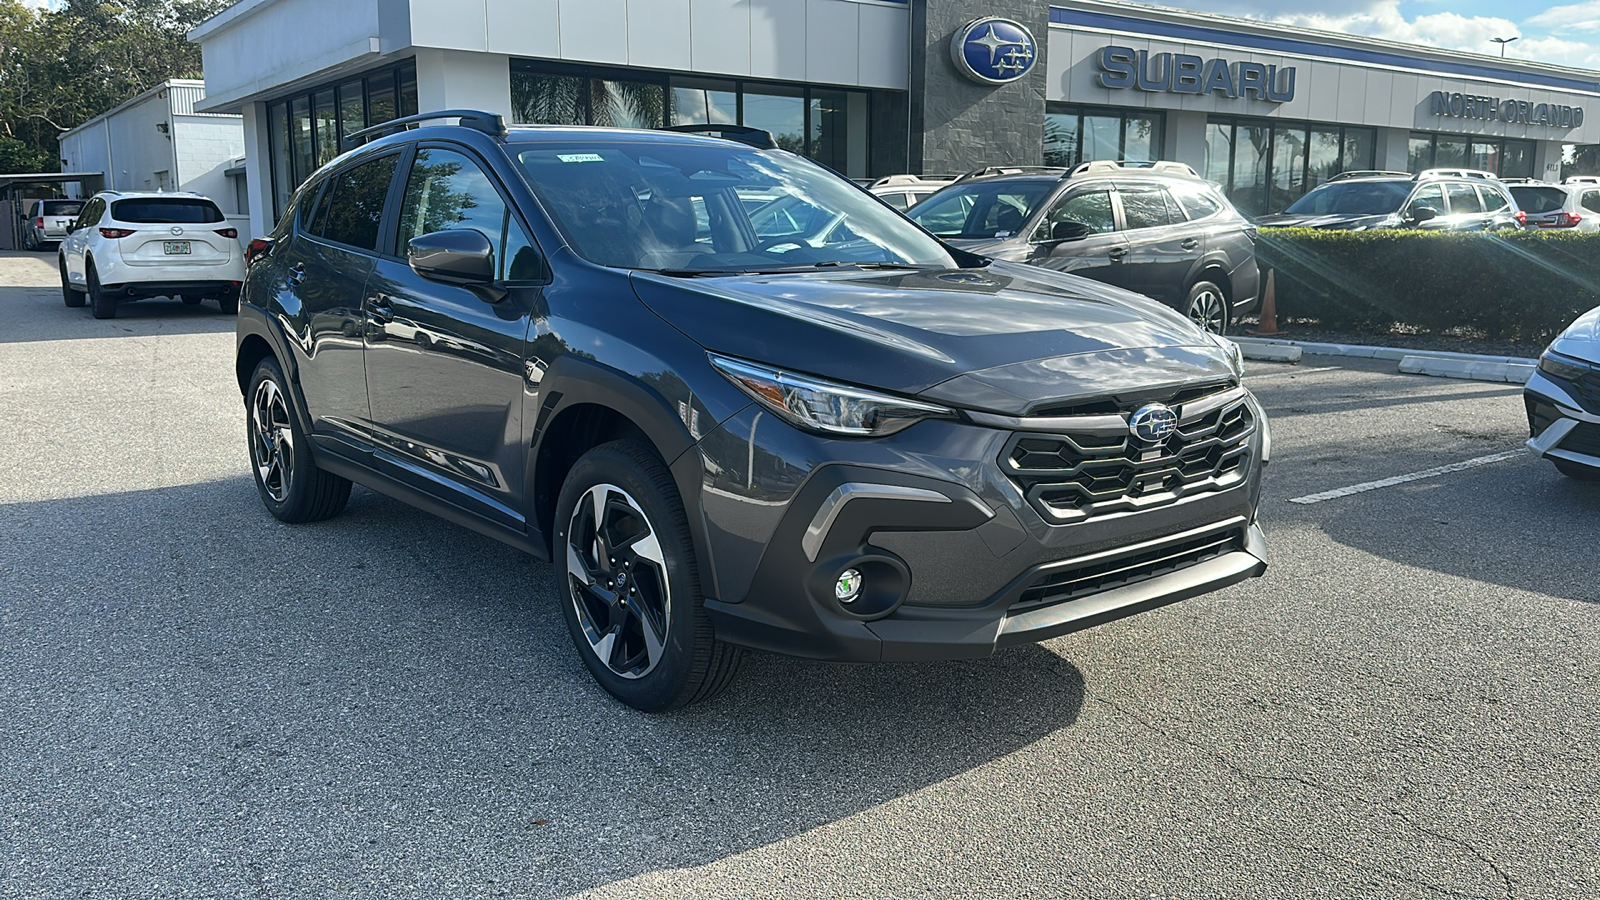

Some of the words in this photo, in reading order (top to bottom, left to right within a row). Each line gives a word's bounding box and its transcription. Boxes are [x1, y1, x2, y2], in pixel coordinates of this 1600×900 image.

[1097, 45, 1296, 102] SUBARU
[1432, 91, 1499, 122] NORTH
[1502, 99, 1584, 128] ORLANDO
